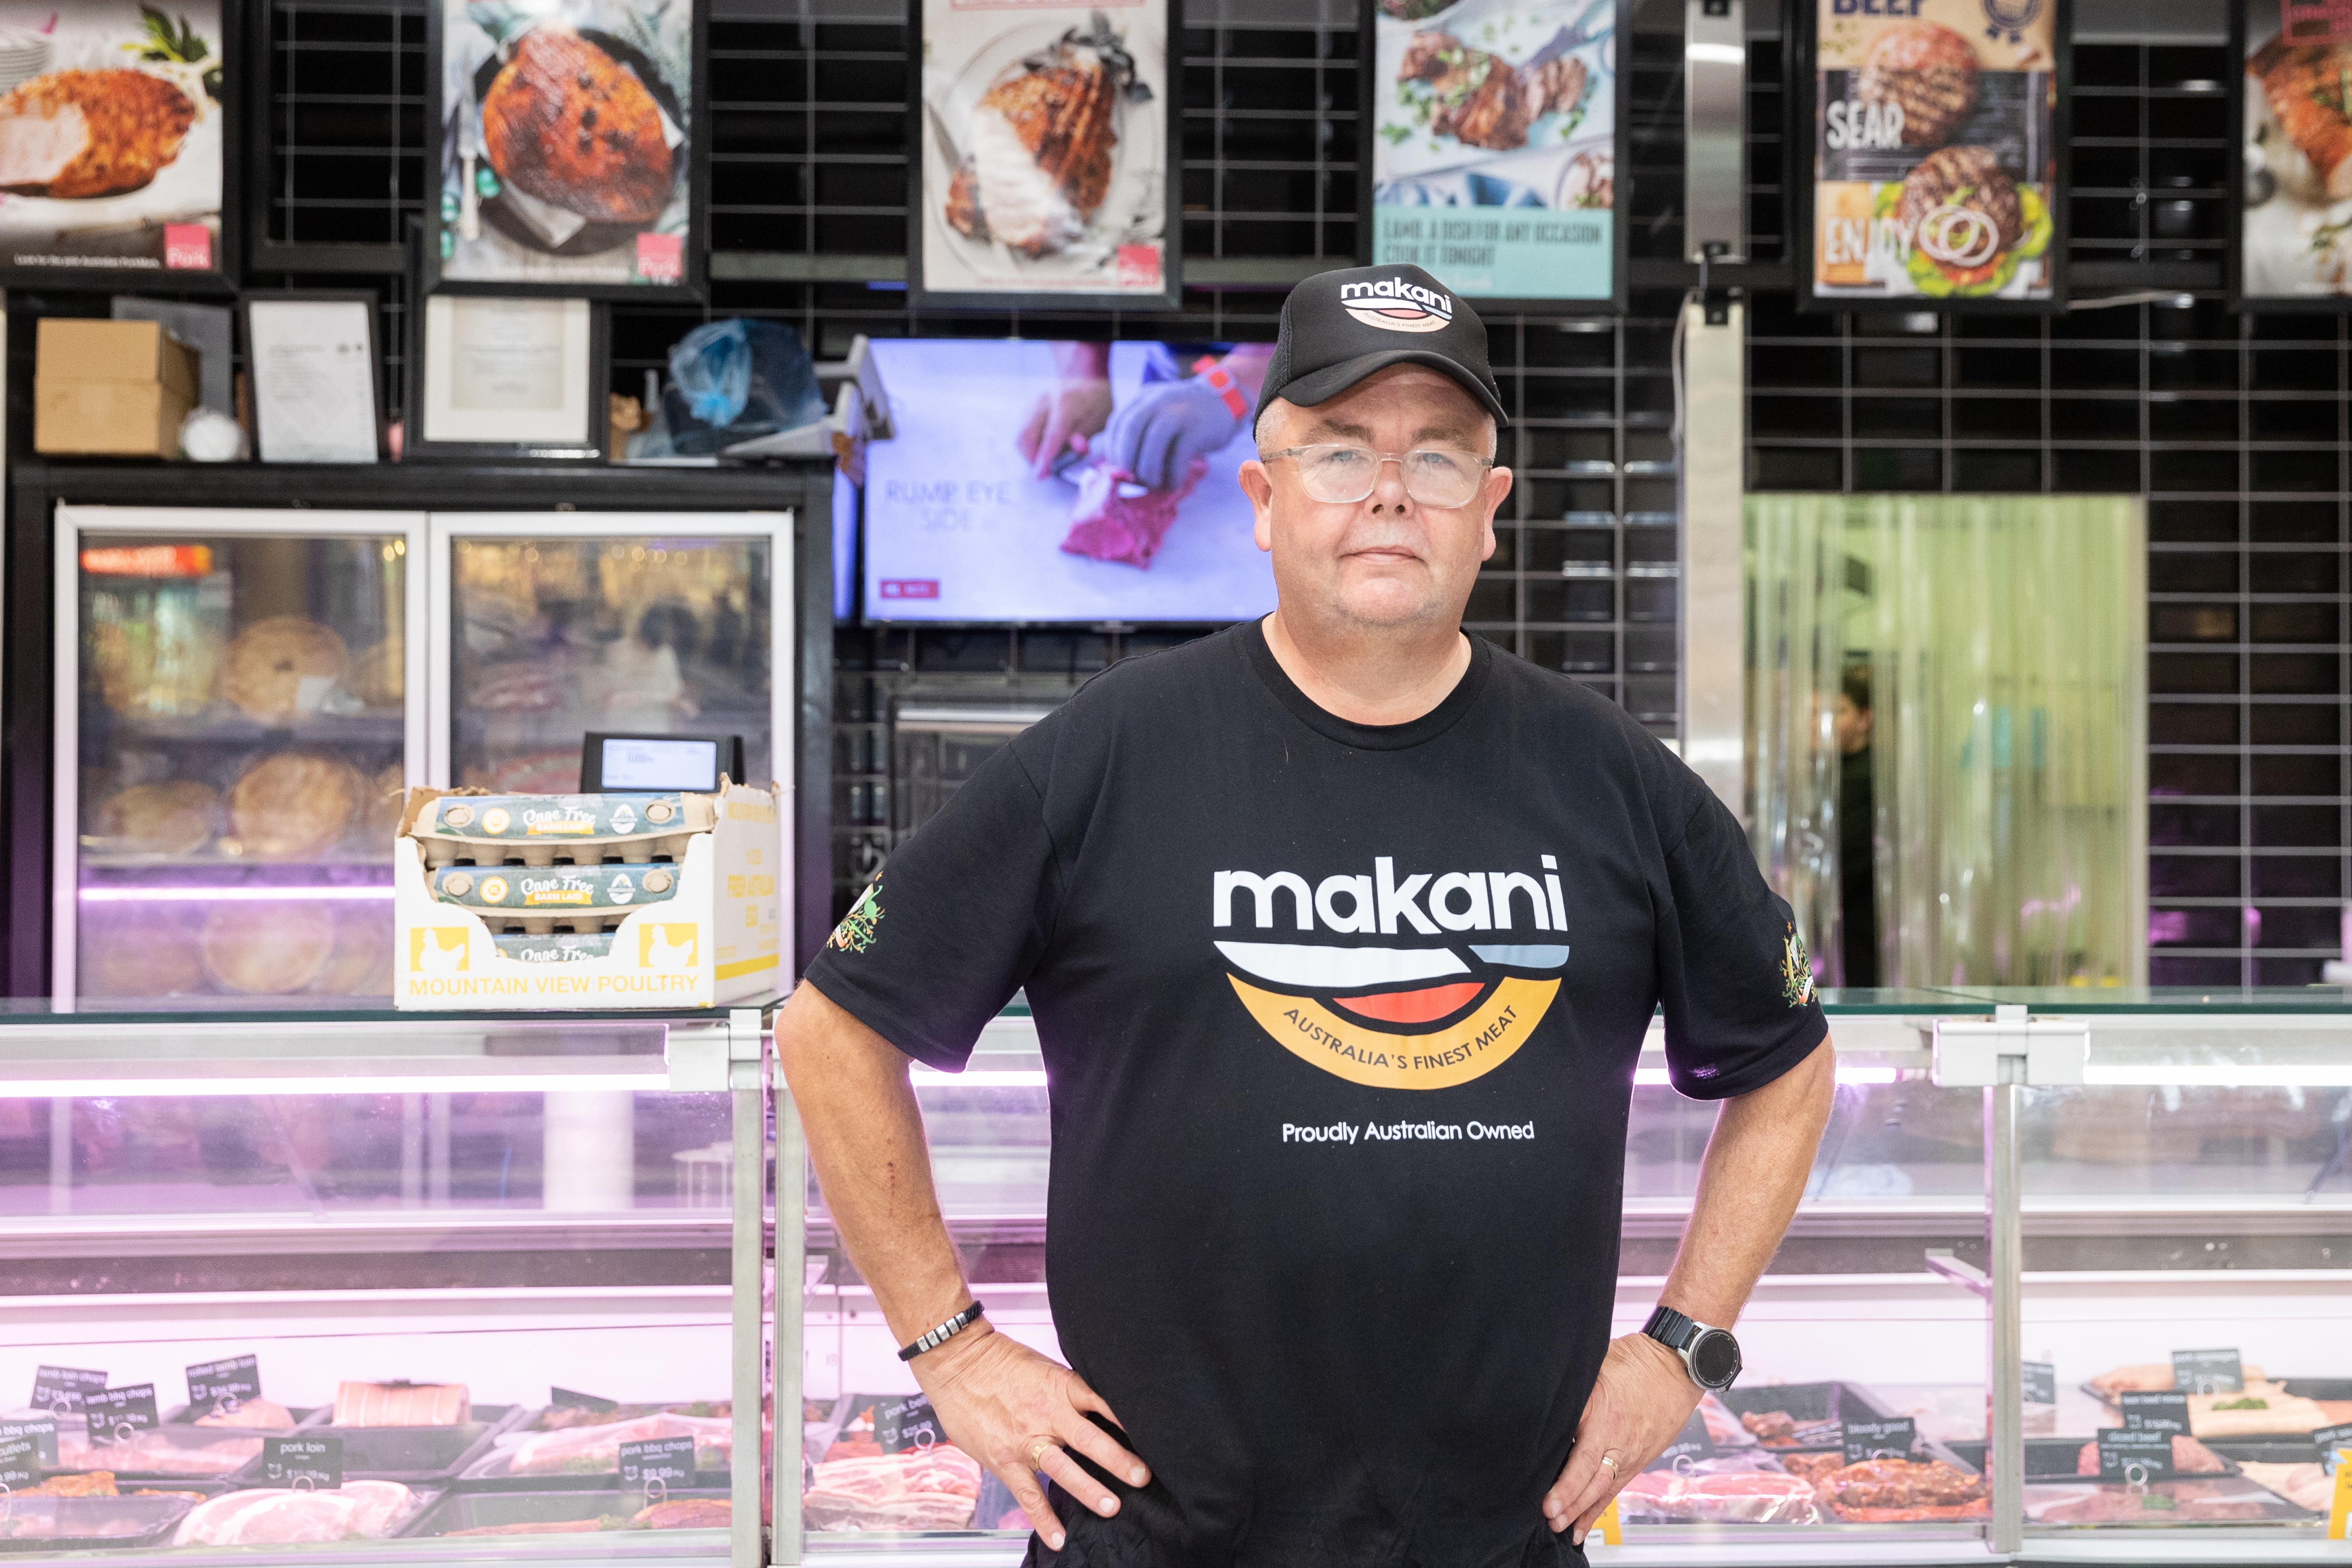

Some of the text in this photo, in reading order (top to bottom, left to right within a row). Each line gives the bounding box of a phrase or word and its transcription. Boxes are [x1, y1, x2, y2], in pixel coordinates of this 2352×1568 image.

[1826, 99, 1905, 150] SEAR
[1534, 222, 1601, 244] OCCASION
[1825, 216, 1918, 263] ENJOY
[1441, 245, 1495, 265] TONIGHT
[1341, 277, 1452, 314] makani
[1363, 312, 1401, 327] AUSTRALIA'S
[1422, 320, 1436, 328] MEAT
[885, 480, 1011, 504] RUMP EYE
[523, 805, 597, 825] Cage Free
[536, 823, 585, 832] BARN LAID
[520, 874, 594, 895] Cage Free
[1213, 854, 1568, 934] makani
[534, 892, 583, 901] BARN LAID
[409, 974, 699, 996] MOUNTAIN VIEW POULTRY
[1283, 1004, 1517, 1070] AUSTRALIA'S FINEST MEAT
[1282, 1120, 1534, 1145] Proudly Australian Owned
[79, 1372, 106, 1384] chops
[85, 1393, 108, 1405] lamb
[126, 1387, 153, 1399] chops
[884, 1403, 909, 1421] pork
[908, 1394, 930, 1410] bell
[3, 1423, 55, 1437] bbq chops
[280, 1442, 326, 1455] pork loin
[621, 1441, 693, 1458] pork bbq chops
